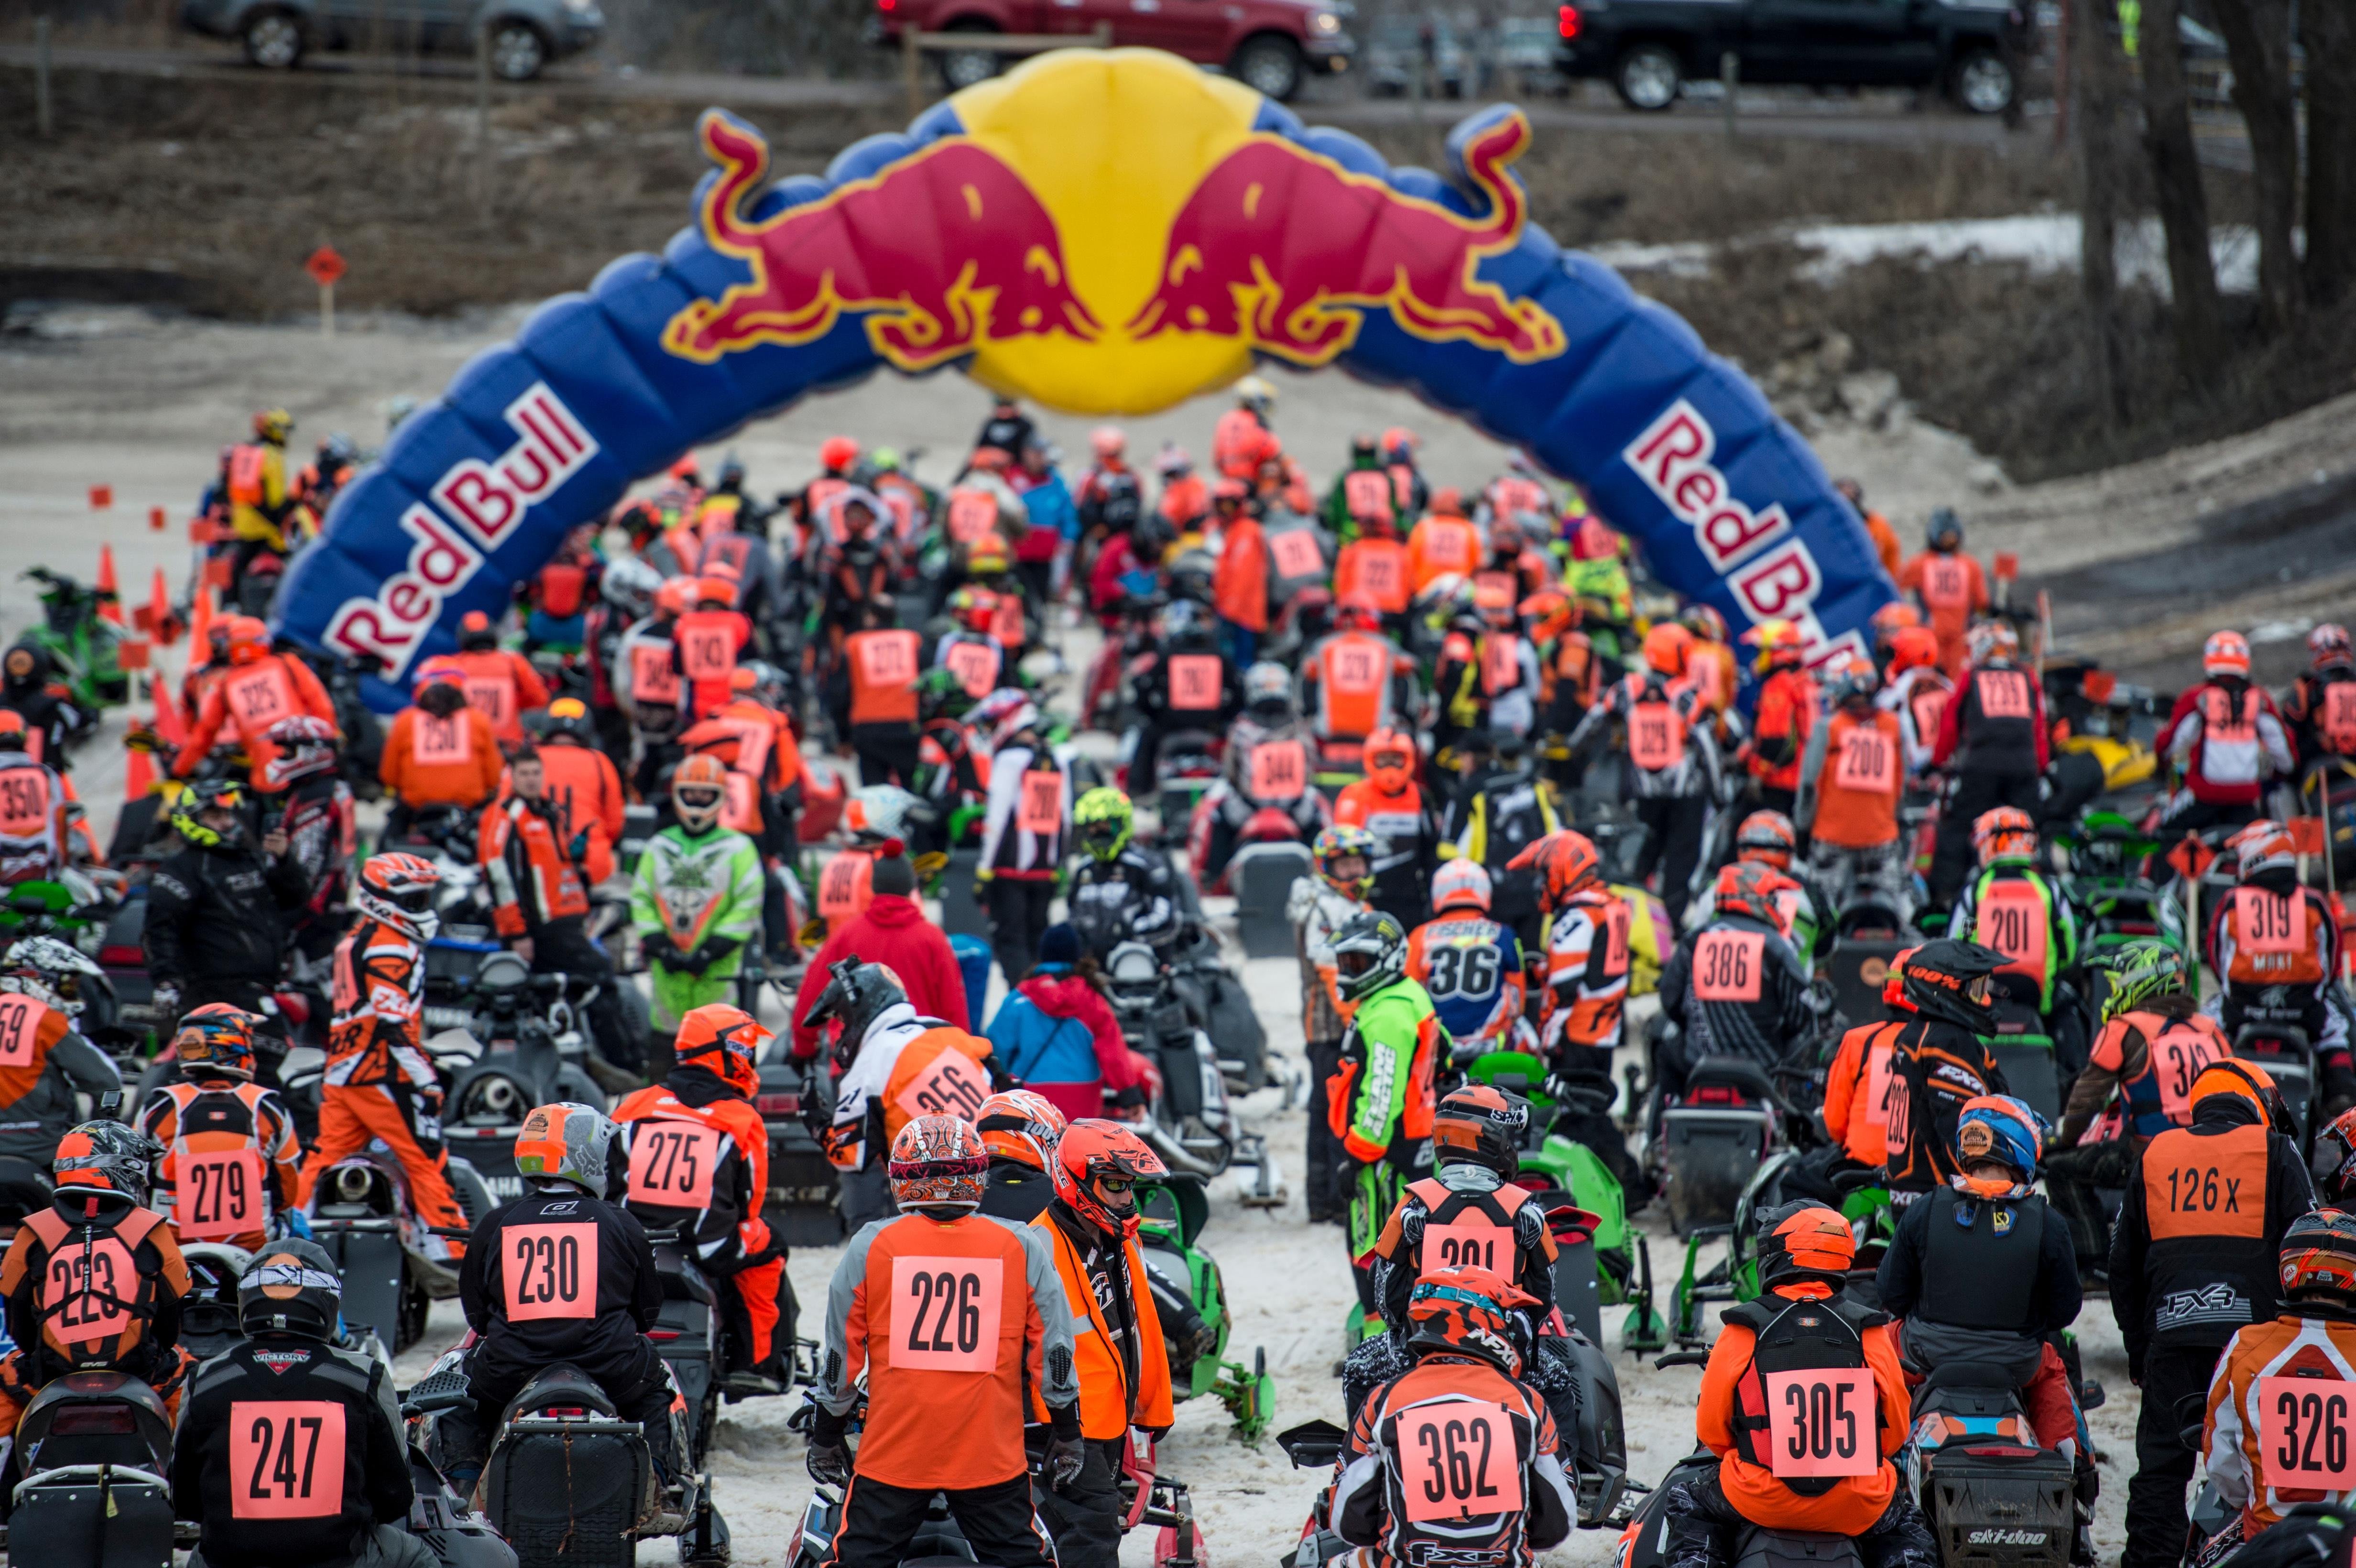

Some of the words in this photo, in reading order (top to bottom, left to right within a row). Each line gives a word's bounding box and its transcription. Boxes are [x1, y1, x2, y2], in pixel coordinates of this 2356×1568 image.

[1631, 407, 1783, 564] Red
[331, 511, 474, 673] Red
[440, 391, 591, 544] Bull
[1847, 737, 1885, 778] 200
[1991, 909, 2030, 953] 201
[2251, 895, 2291, 941] 319
[1429, 944, 1503, 1003] 36
[1703, 942, 1750, 988] 386
[1887, 1082, 1908, 1144] 232
[191, 1159, 247, 1223] 279
[643, 1132, 701, 1193] 275
[52, 1251, 120, 1328] 223
[516, 1234, 579, 1306] 230
[907, 1271, 981, 1354] 226
[254, 1352, 308, 1361] VICTORY
[1785, 1382, 1856, 1460] 305
[2278, 1391, 2347, 1474] 326
[248, 1416, 324, 1500] 247
[1417, 1417, 1498, 1503] 362
